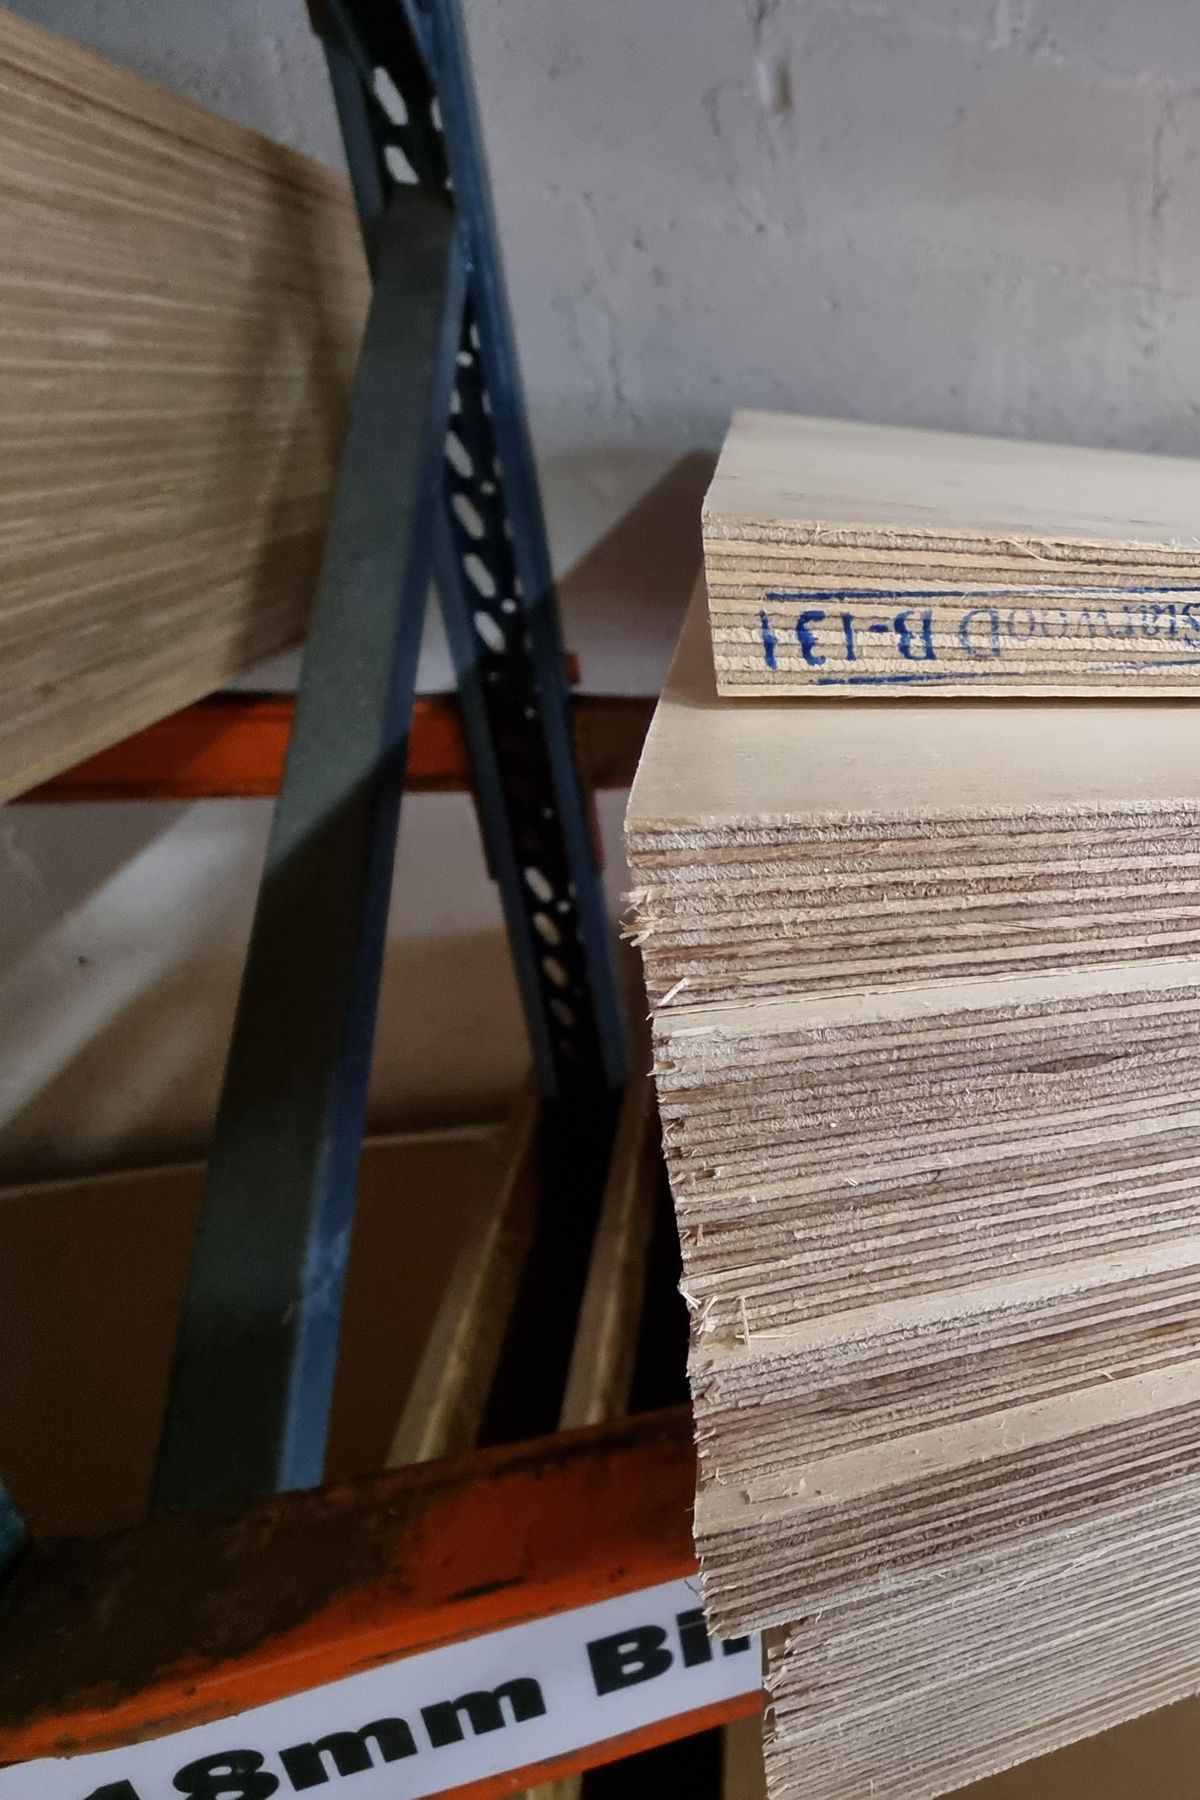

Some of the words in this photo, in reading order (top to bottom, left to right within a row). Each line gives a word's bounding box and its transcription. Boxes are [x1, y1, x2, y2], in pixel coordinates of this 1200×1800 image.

[760, 609, 936, 670] B-131
[83, 1676, 547, 1800] 8mm
[586, 1606, 751, 1697] Bi
